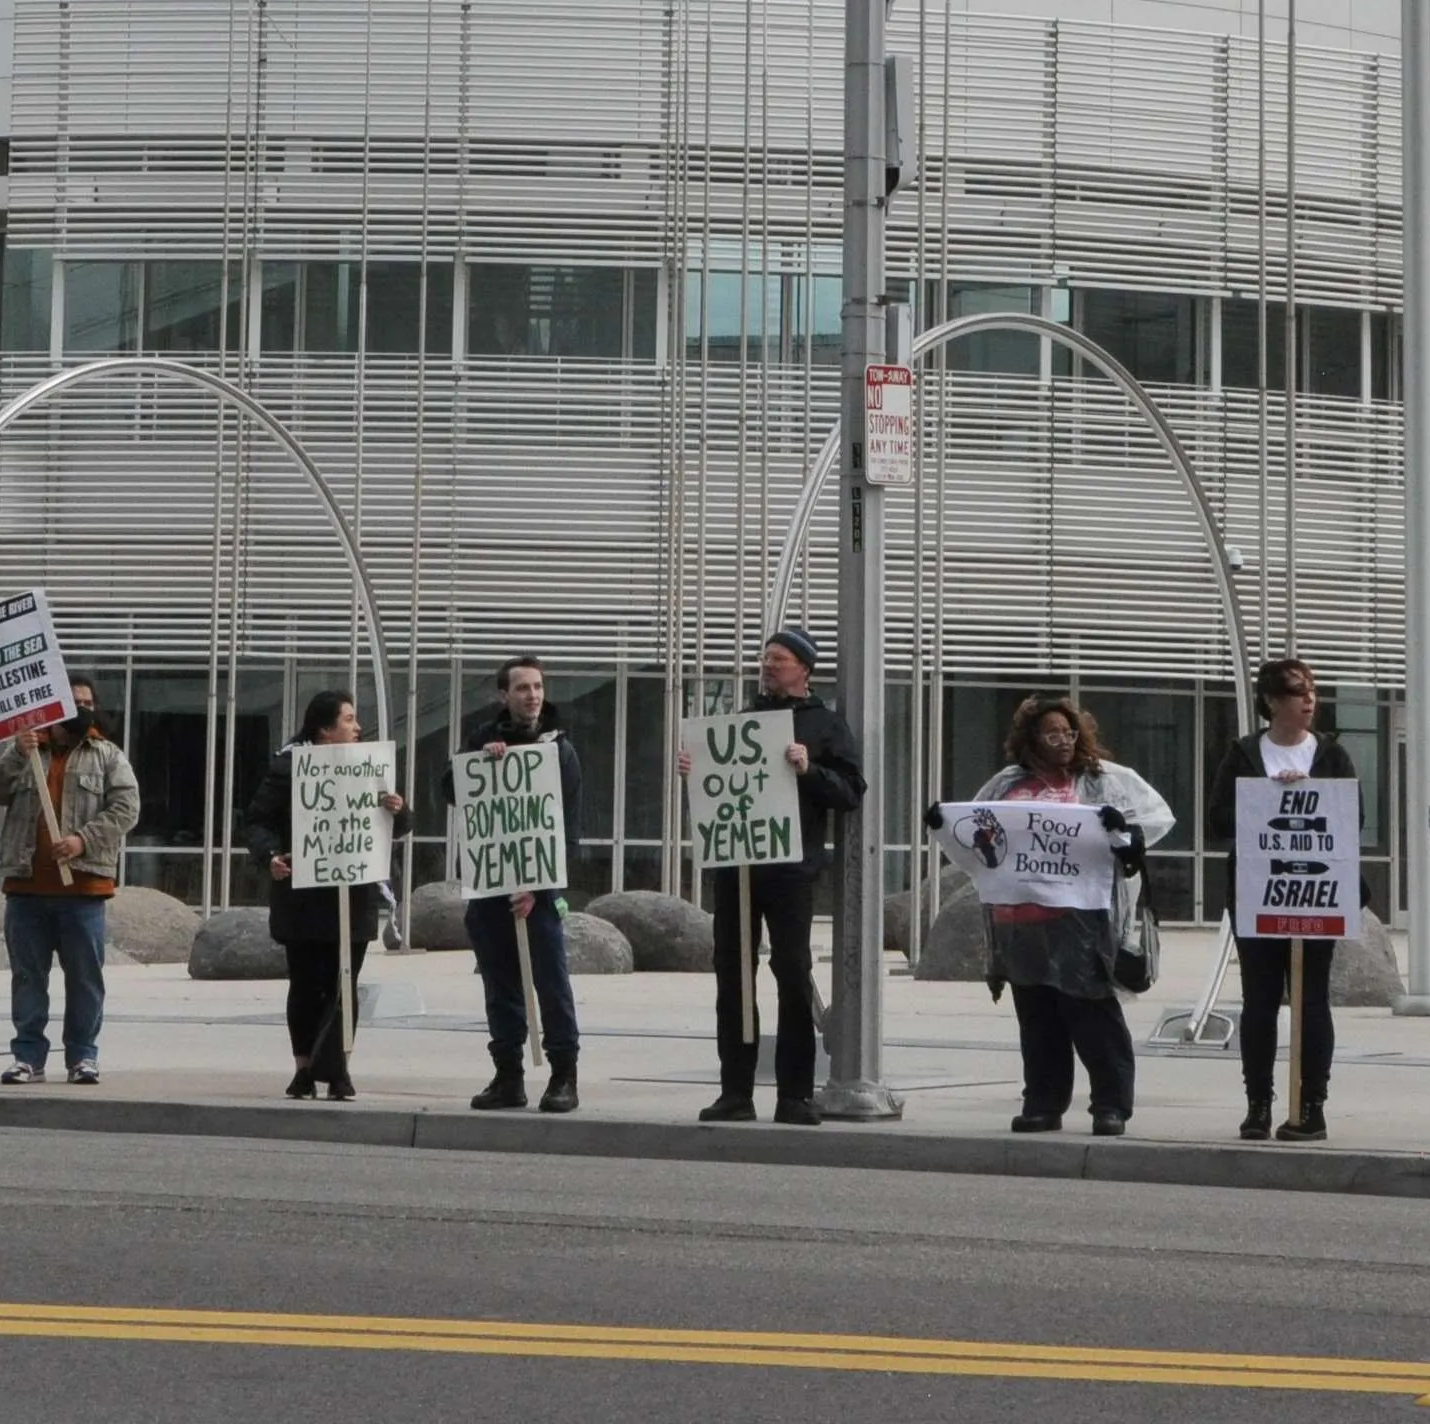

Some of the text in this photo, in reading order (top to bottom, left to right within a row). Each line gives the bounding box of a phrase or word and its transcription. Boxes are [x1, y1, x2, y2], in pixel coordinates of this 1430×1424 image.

[867, 385, 882, 408] NO
[869, 414, 909, 436] STOPPING
[870, 439, 909, 456] ANY TIME
[8, 595, 35, 615] RIVER
[3, 644, 22, 662] THE
[23, 636, 44, 655] SEA
[14, 694, 28, 708] BE
[29, 684, 54, 702] FREE
[706, 719, 768, 766] U.S.
[297, 753, 390, 777] Not another
[465, 750, 543, 798] STOP
[703, 768, 770, 798] out
[301, 779, 337, 812] U.S.
[1279, 790, 1320, 815] END
[463, 793, 556, 841] BOMBING
[716, 794, 755, 822] of
[313, 812, 371, 833] in the
[1026, 812, 1082, 838] Food
[303, 834, 374, 858] Middle
[697, 815, 791, 862] YEMEN
[1030, 832, 1070, 856] Not
[1258, 833, 1334, 852] U.S. AID TO
[314, 858, 368, 882] East
[467, 835, 557, 890] YEMEN
[1014, 852, 1081, 876] Bombs
[1262, 879, 1340, 908] ISRAEL
